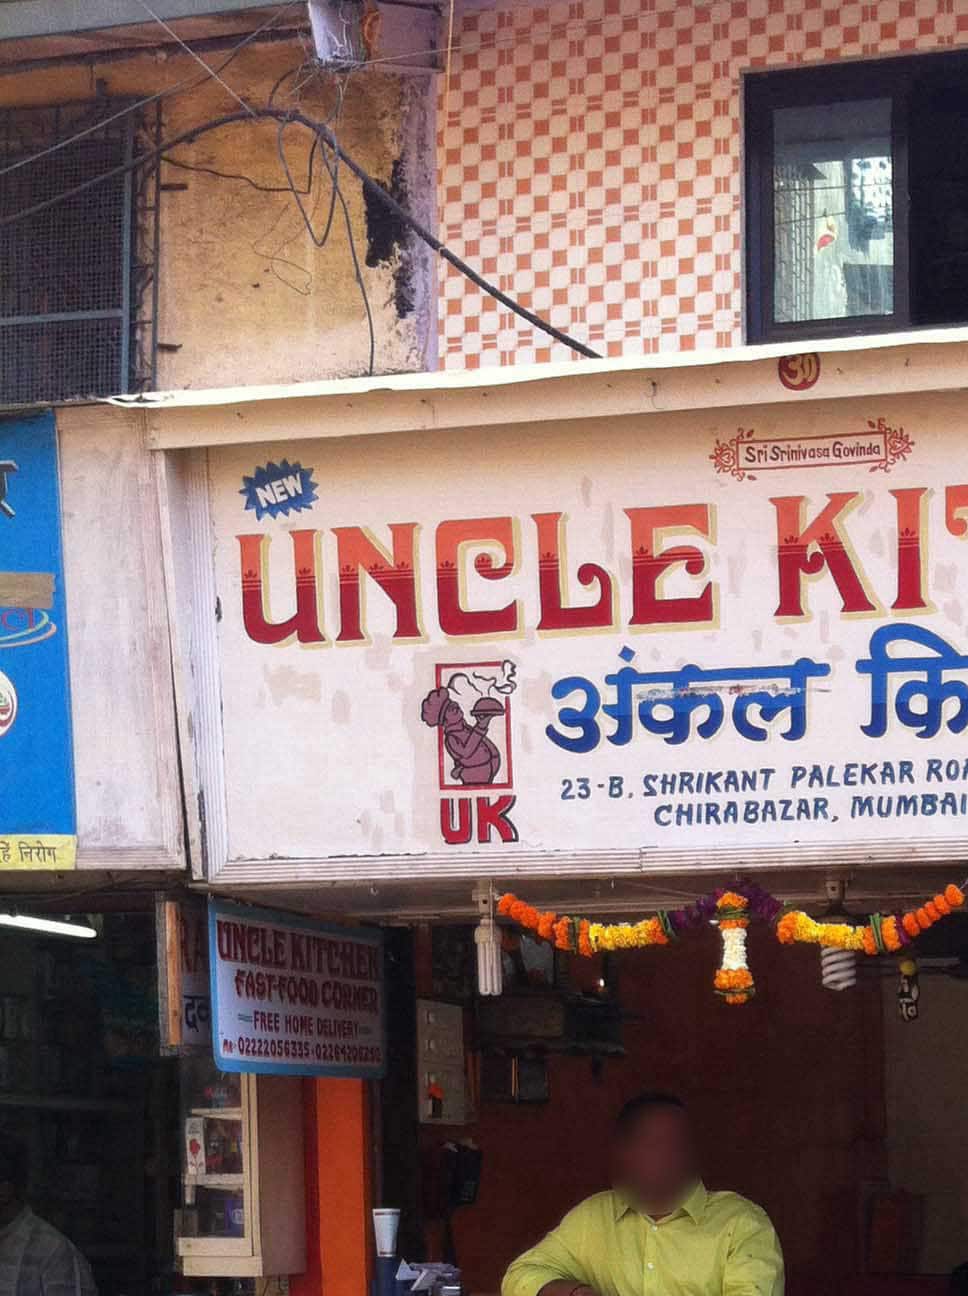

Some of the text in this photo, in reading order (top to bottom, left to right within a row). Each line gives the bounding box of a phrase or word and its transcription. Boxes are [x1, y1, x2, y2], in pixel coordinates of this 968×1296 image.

[744, 440, 881, 464] Sri Srinivasa Govinda
[254, 472, 304, 511] NEW
[236, 502, 717, 648] UNCLE
[544, 644, 831, 754] अंकल
[642, 767, 776, 797] SHRIKANT
[790, 756, 915, 789] PALEKAR
[439, 793, 520, 845] UK
[653, 797, 840, 827] CHIRABAZAR,
[217, 919, 287, 967] UNCLE
[253, 1010, 280, 1033] FREE
[285, 1014, 315, 1036] HOME
